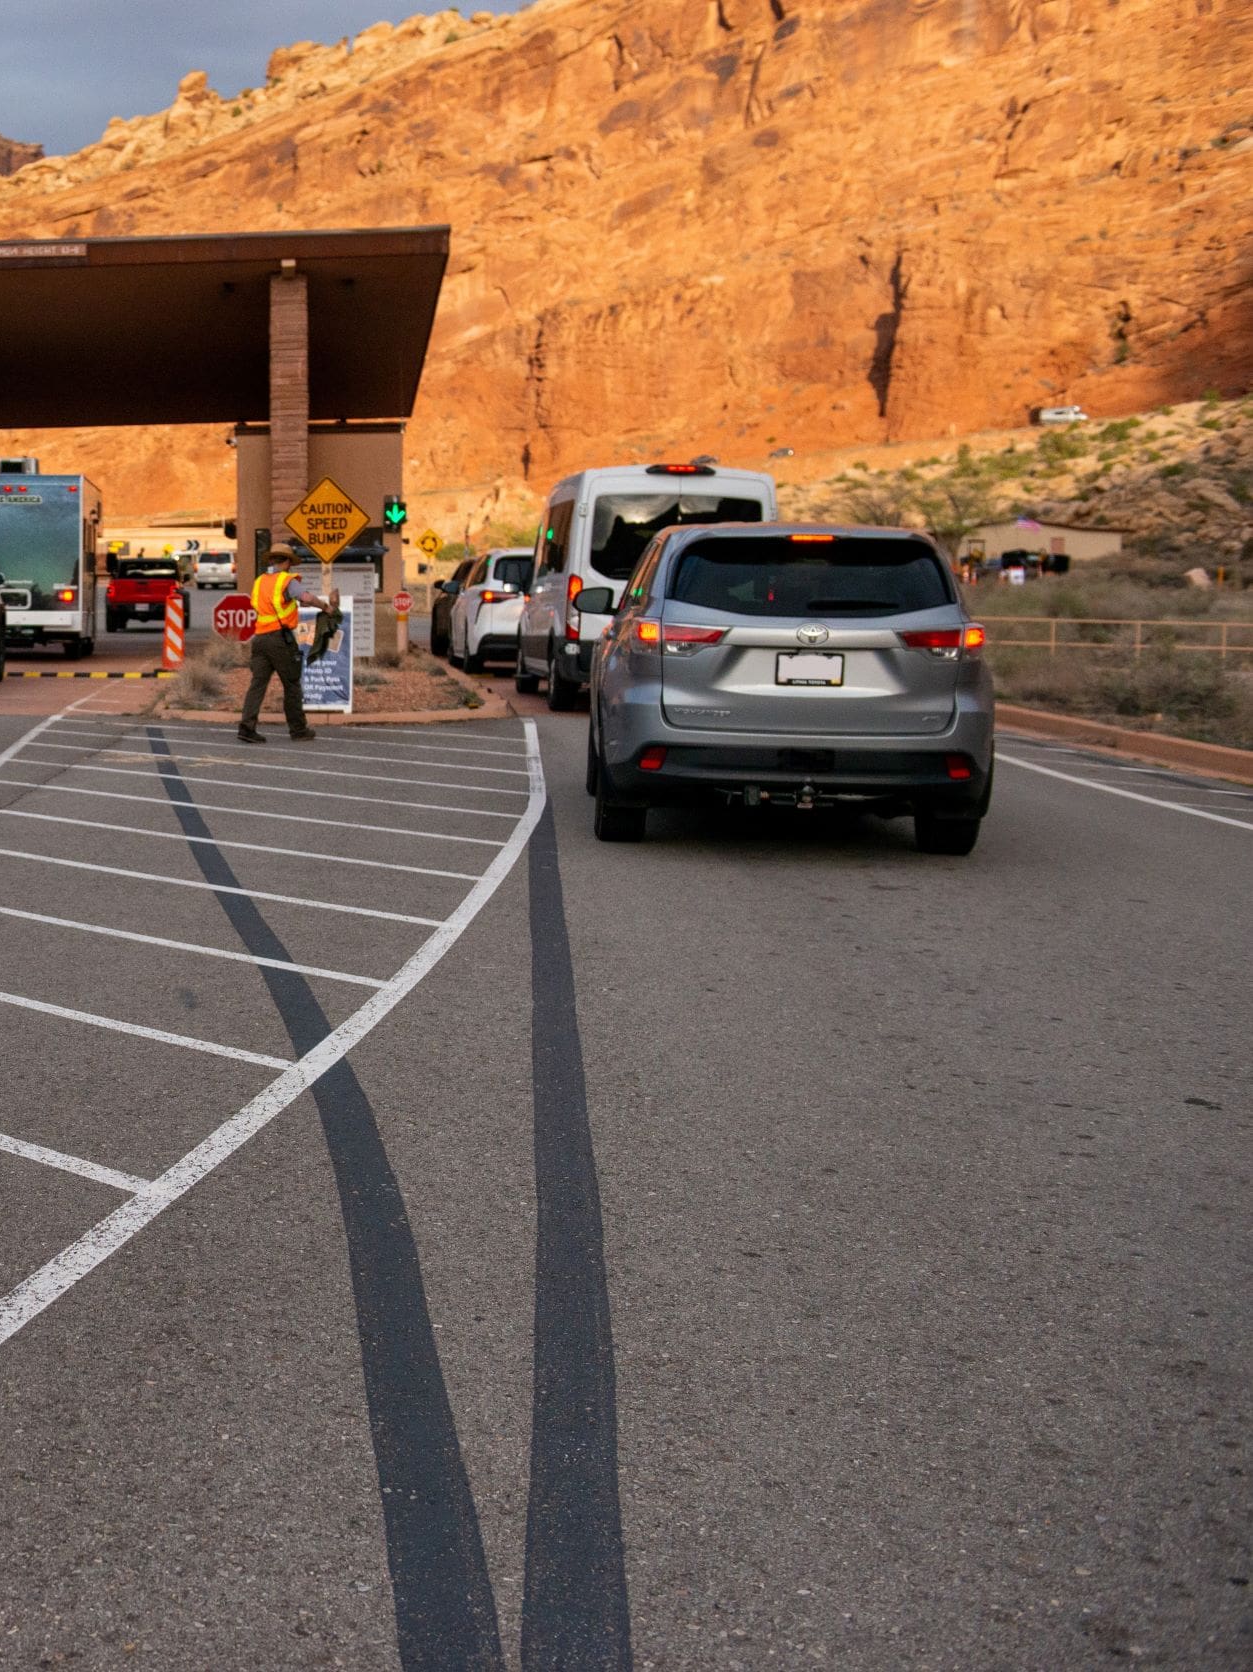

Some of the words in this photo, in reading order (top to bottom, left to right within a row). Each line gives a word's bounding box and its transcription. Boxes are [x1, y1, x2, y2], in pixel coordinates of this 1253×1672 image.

[7, 495, 41, 503] AMERICA
[300, 502, 353, 515] CAUTION
[306, 517, 348, 530] SPEED
[308, 532, 346, 544] BUMP
[393, 597, 411, 606] STOP
[217, 609, 257, 628] STOP
